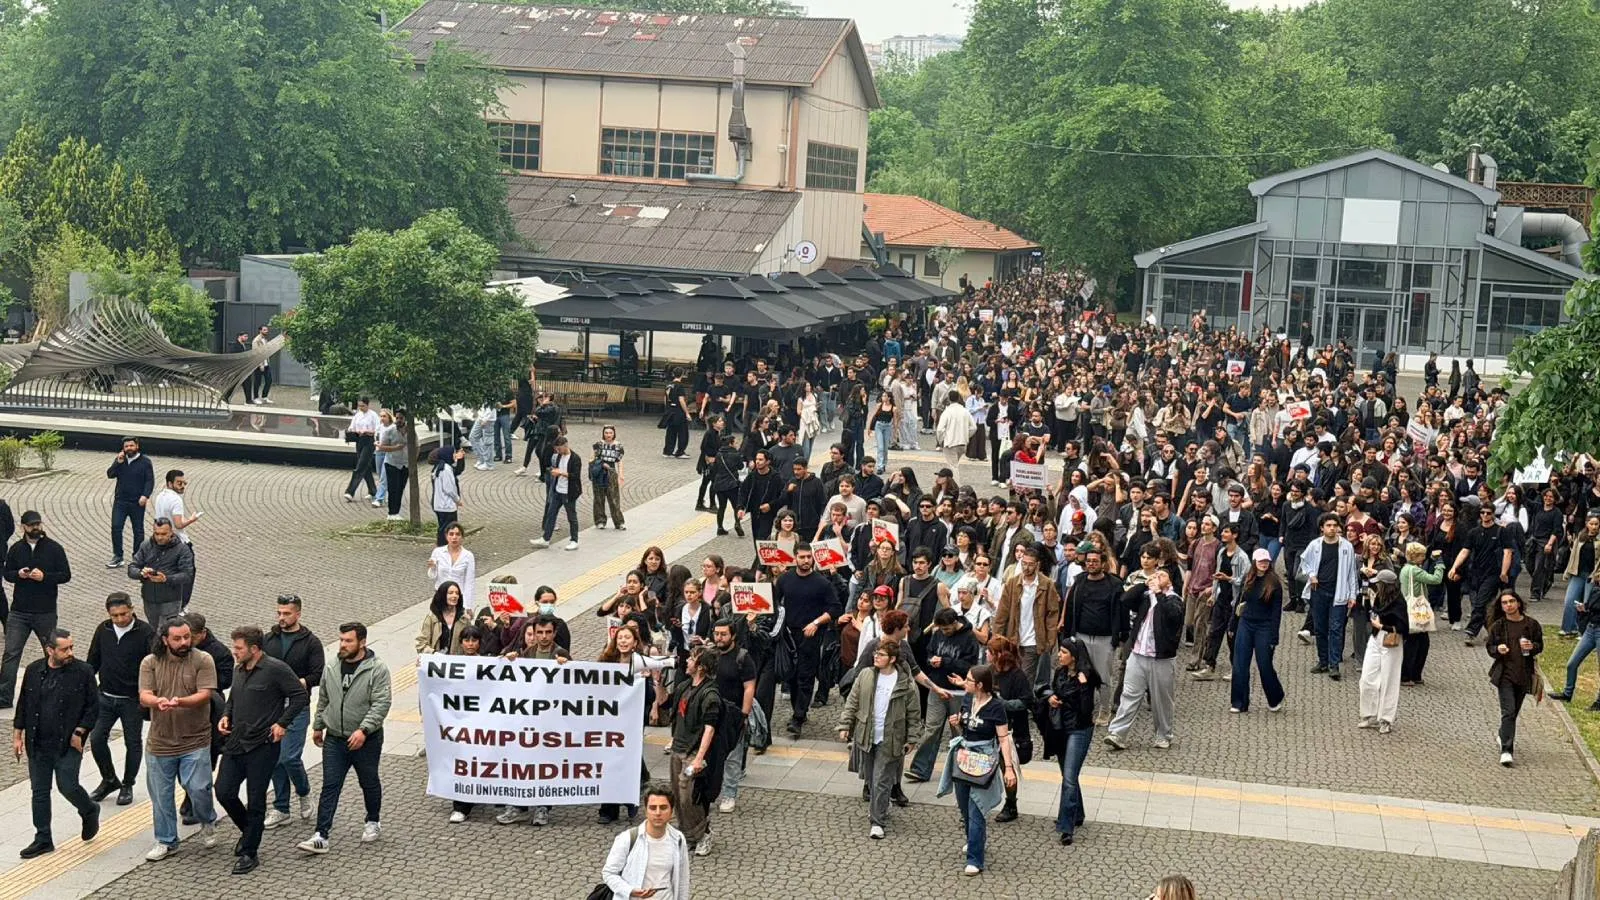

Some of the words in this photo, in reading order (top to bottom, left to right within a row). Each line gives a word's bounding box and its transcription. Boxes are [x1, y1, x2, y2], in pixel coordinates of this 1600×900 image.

[428, 662, 466, 680] NE
[476, 664, 634, 686] KAYYIMIN
[443, 693, 480, 712] NE
[439, 724, 625, 748] KAMPÜSLER
[454, 756, 603, 780] BİZİMDİR!
